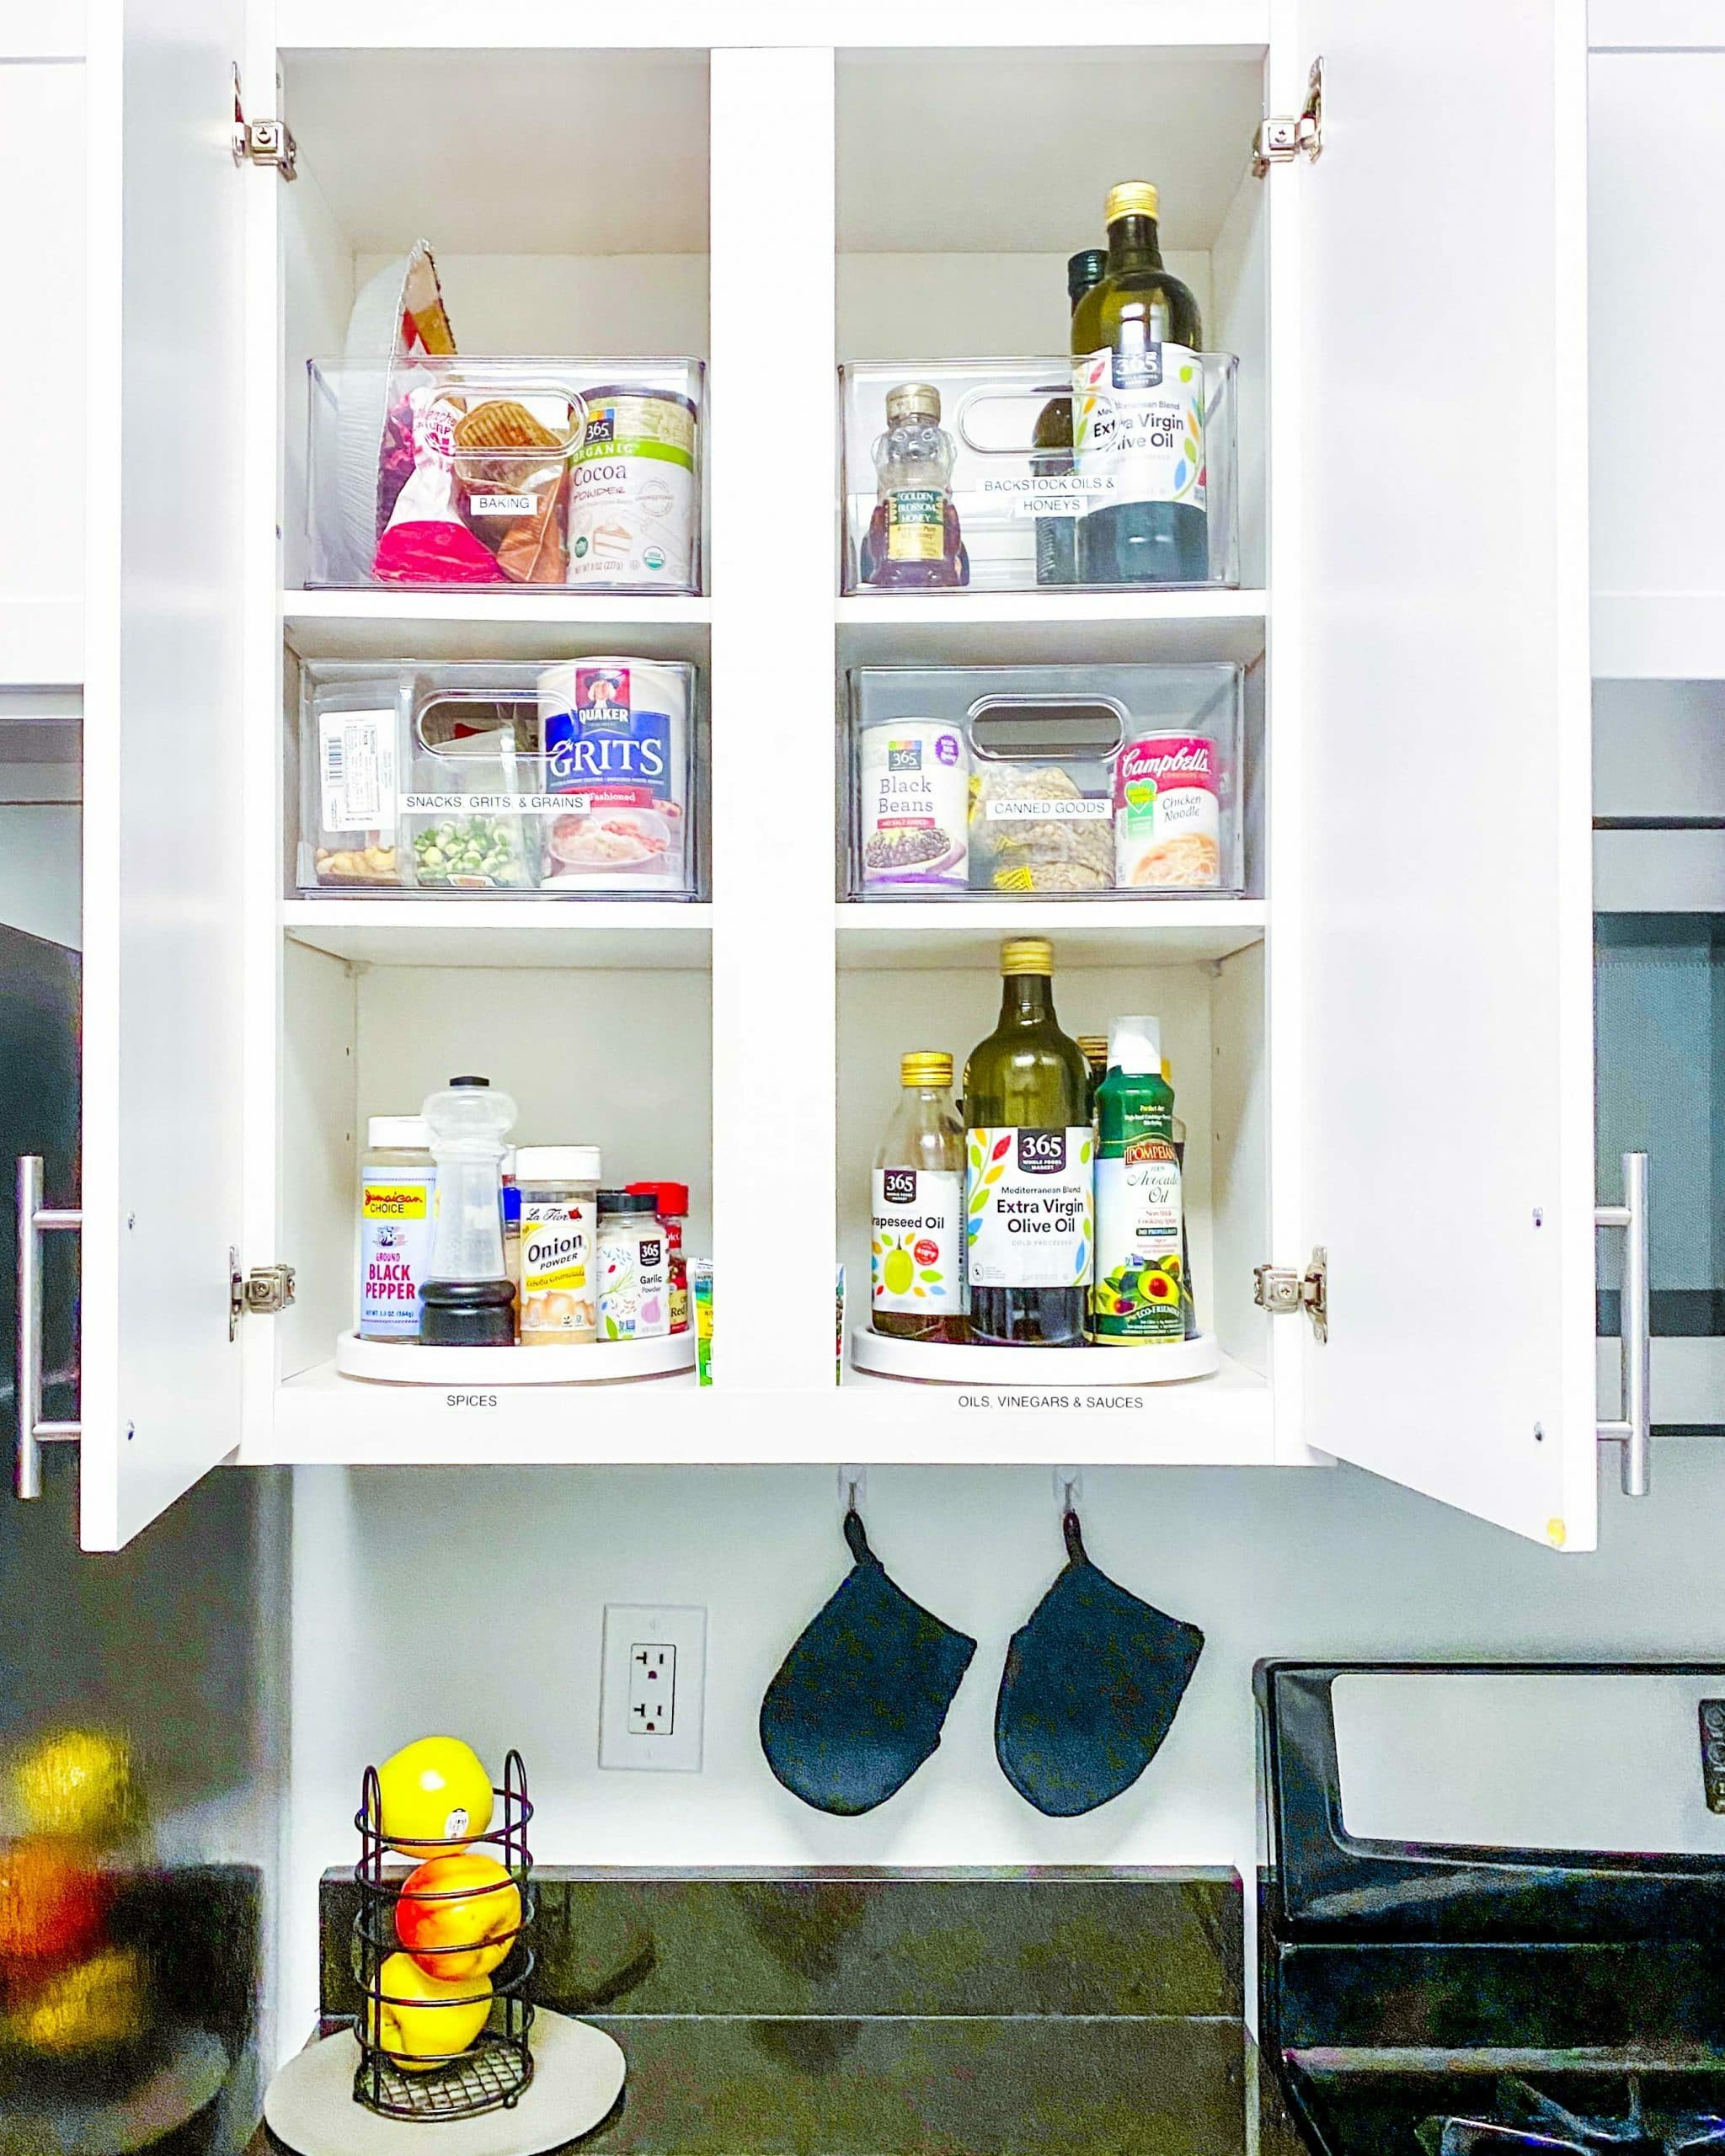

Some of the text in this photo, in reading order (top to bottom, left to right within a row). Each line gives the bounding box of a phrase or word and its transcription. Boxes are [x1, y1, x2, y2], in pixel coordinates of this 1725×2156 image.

[1116, 351, 1158, 376] 365
[1158, 400, 1180, 410] Blend
[1138, 413, 1184, 431] Virgin
[587, 421, 610, 440] 365
[1151, 432, 1173, 448] Oil
[573, 442, 635, 462] ORGANIC
[574, 464, 627, 487] Cocoa
[984, 475, 1115, 492] BACKSTOCK OILS &
[479, 497, 530, 509] BAKING
[574, 486, 626, 504] POWDER
[900, 491, 935, 501] GOLDEN
[898, 503, 936, 513] BLOSSOM
[1023, 499, 1081, 512] HONEYS
[901, 514, 930, 523] HONEY
[579, 708, 629, 723] QUAKER
[550, 738, 664, 776] GRITS
[893, 750, 916, 767] 365
[1122, 746, 1211, 778] Campbell's
[880, 776, 932, 794] Black
[518, 797, 527, 808] &
[531, 797, 584, 808] GRAINS
[878, 798, 933, 814] Beans
[995, 802, 1106, 814] CANNED GOODS
[1162, 794, 1201, 810] Chicken
[1164, 806, 1200, 824] Noodle
[1022, 1134, 1062, 1157] 365
[886, 1174, 913, 1192] 365
[1001, 1186, 1081, 1194] Mediterranean Blend
[1148, 1187, 1169, 1203] Oil
[370, 1203, 405, 1214] CHOICE
[996, 1199, 1084, 1216] Extra Virgin
[872, 1216, 944, 1230] rapeseed Oil
[1007, 1218, 1075, 1233] Olive Oil
[528, 1234, 583, 1262] Onion
[641, 1244, 660, 1258] 365
[376, 1252, 400, 1262] GROUND
[540, 1252, 578, 1270] POWDER
[369, 1264, 410, 1281] BLACK
[639, 1274, 663, 1285] Garlic
[366, 1283, 415, 1299] PEPPER
[641, 1285, 661, 1294] Powder
[670, 1305, 685, 1317] Red
[446, 1395, 498, 1406] SPICES
[959, 1396, 1144, 1408] OILS, VINEGARS & SAUCES
